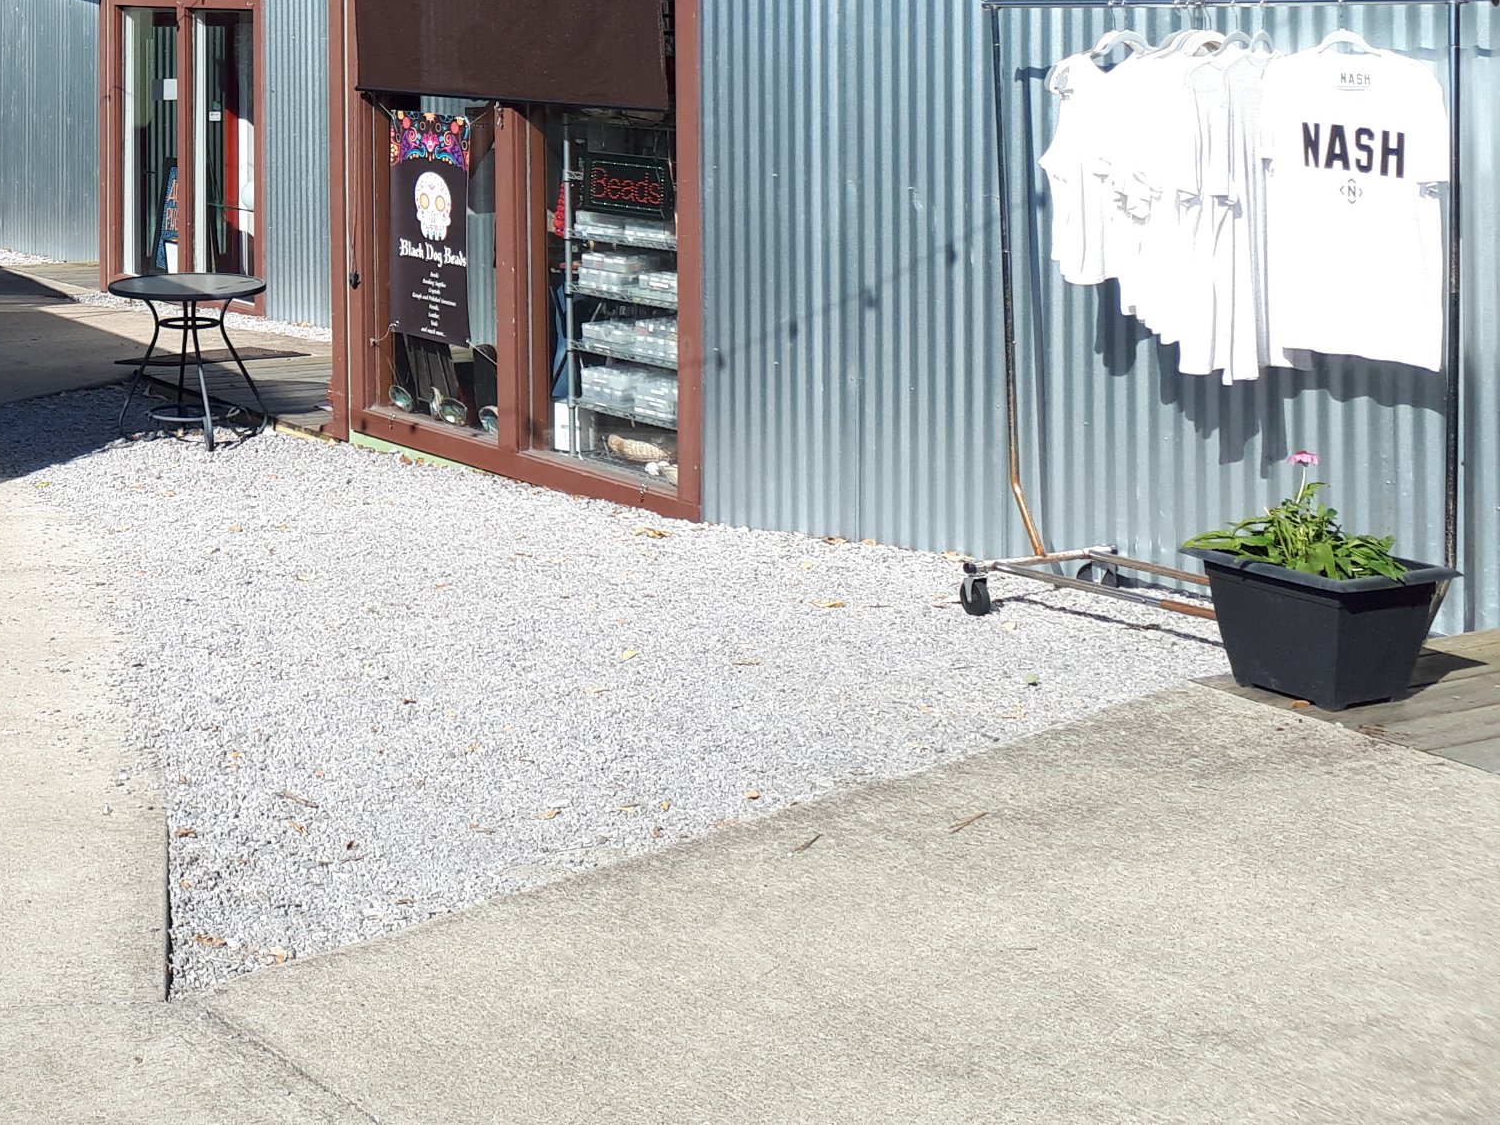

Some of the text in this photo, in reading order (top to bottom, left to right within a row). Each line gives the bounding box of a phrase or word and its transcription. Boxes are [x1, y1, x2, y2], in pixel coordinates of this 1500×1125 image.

[1340, 72, 1371, 85] NASH
[1301, 121, 1405, 179] NASH
[592, 167, 661, 204] Beads
[399, 238, 467, 268] Black Dog Beads
